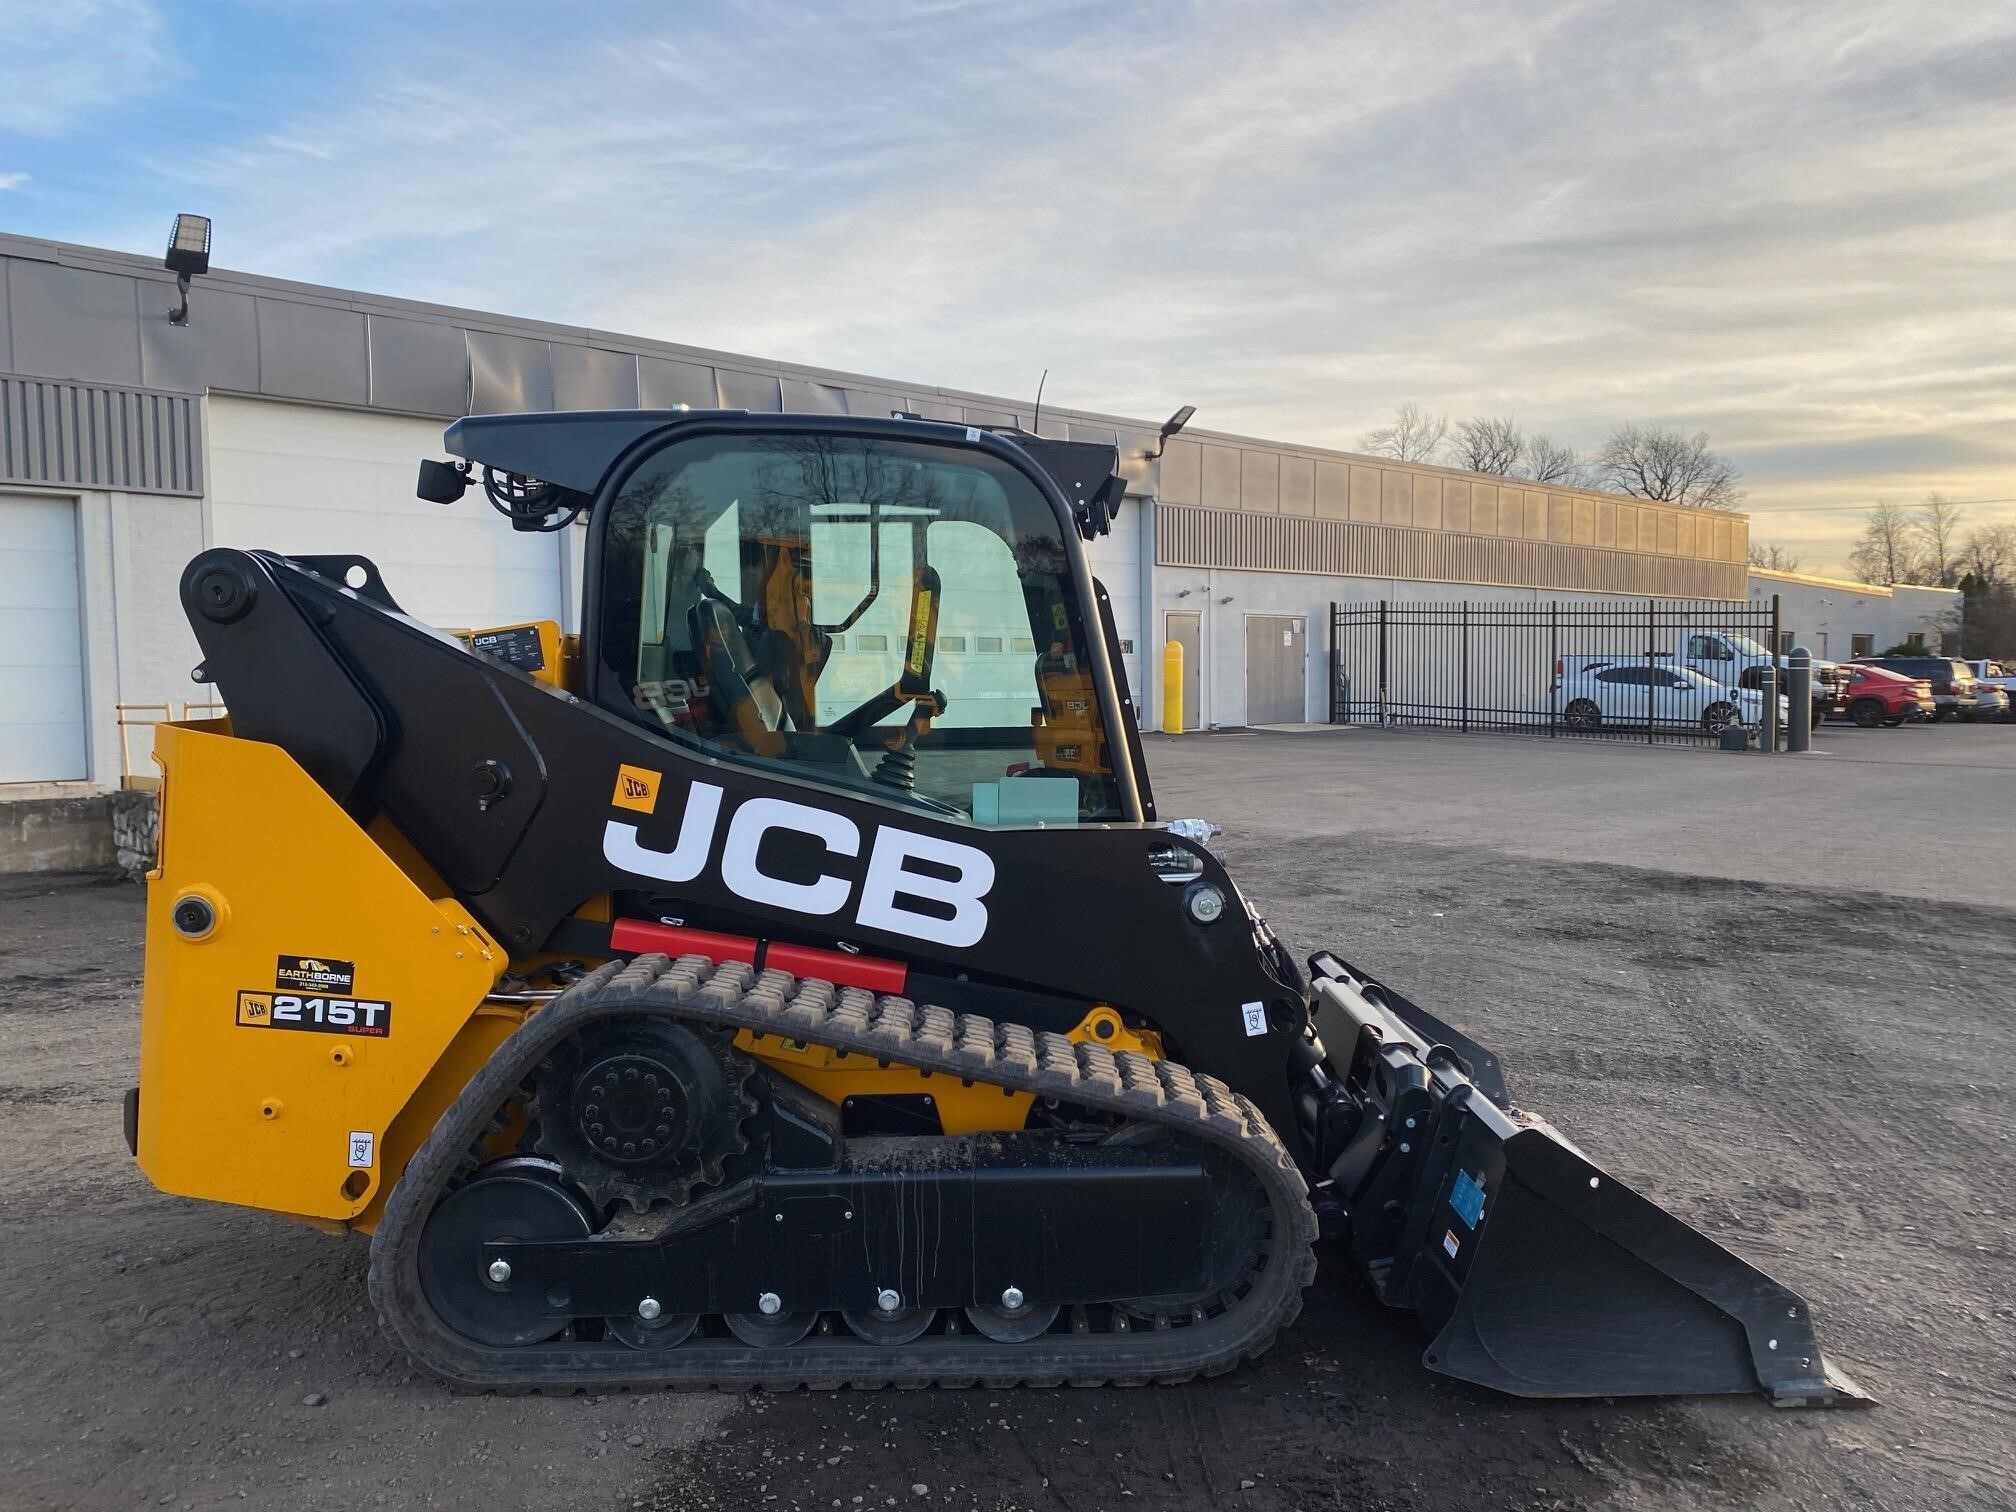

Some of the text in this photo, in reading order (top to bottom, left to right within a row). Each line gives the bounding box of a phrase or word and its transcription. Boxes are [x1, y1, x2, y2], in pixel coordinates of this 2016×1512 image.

[475, 636, 497, 645] JCB
[626, 778, 648, 797] JCB
[602, 780, 996, 948] JCB
[278, 968, 351, 983] EARTHBORNE
[248, 996, 385, 1026] JCB 215T
[347, 1026, 383, 1035] SUPER
